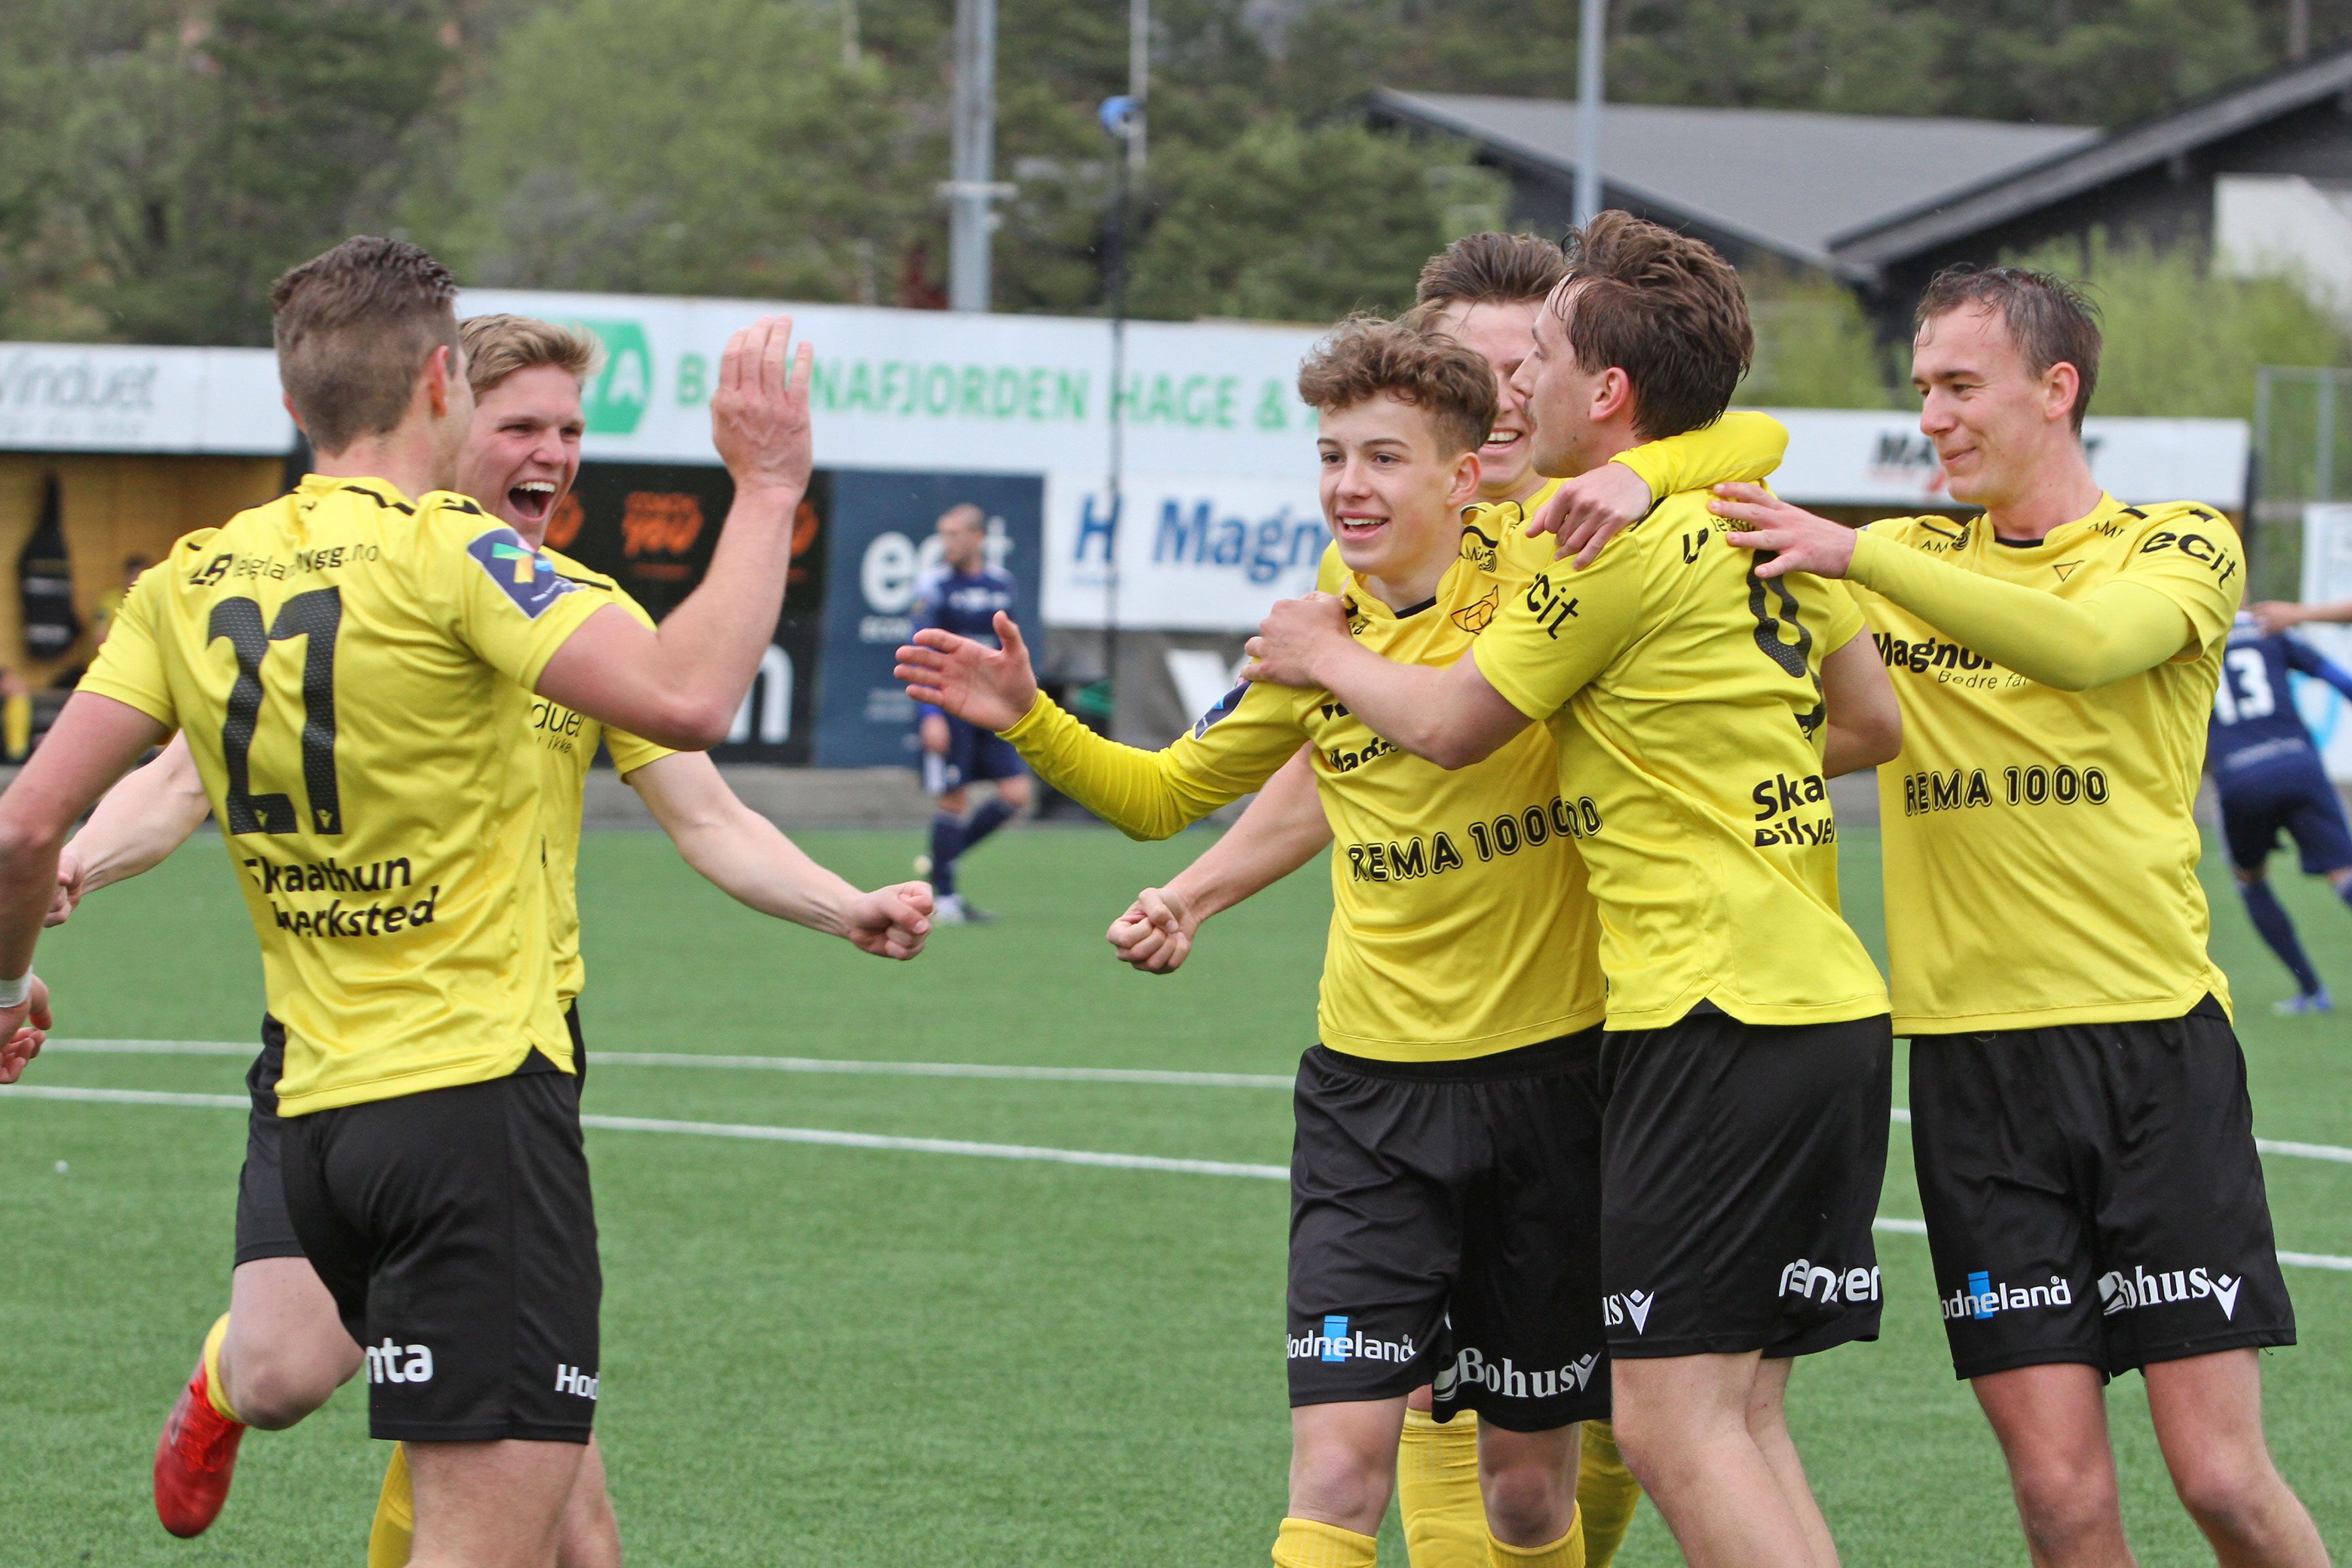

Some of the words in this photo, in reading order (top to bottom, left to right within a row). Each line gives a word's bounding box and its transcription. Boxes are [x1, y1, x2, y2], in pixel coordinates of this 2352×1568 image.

[676, 351, 1091, 422] BNAFJORDEN
[1109, 372, 1239, 429] HAGE
[1254, 376, 1290, 430] &
[1151, 495, 1330, 583] Magn
[2139, 532, 2236, 590] ecit
[1526, 572, 1579, 640] cit
[1872, 632, 1993, 674] Magno
[1938, 670, 1998, 689] Bedre
[1904, 768, 1993, 817] REMA
[2003, 765, 2110, 806] 1000
[1347, 832, 1463, 881] REMA
[1939, 1278, 2072, 1320] odneland
[1457, 1347, 1576, 1398] Bohus
